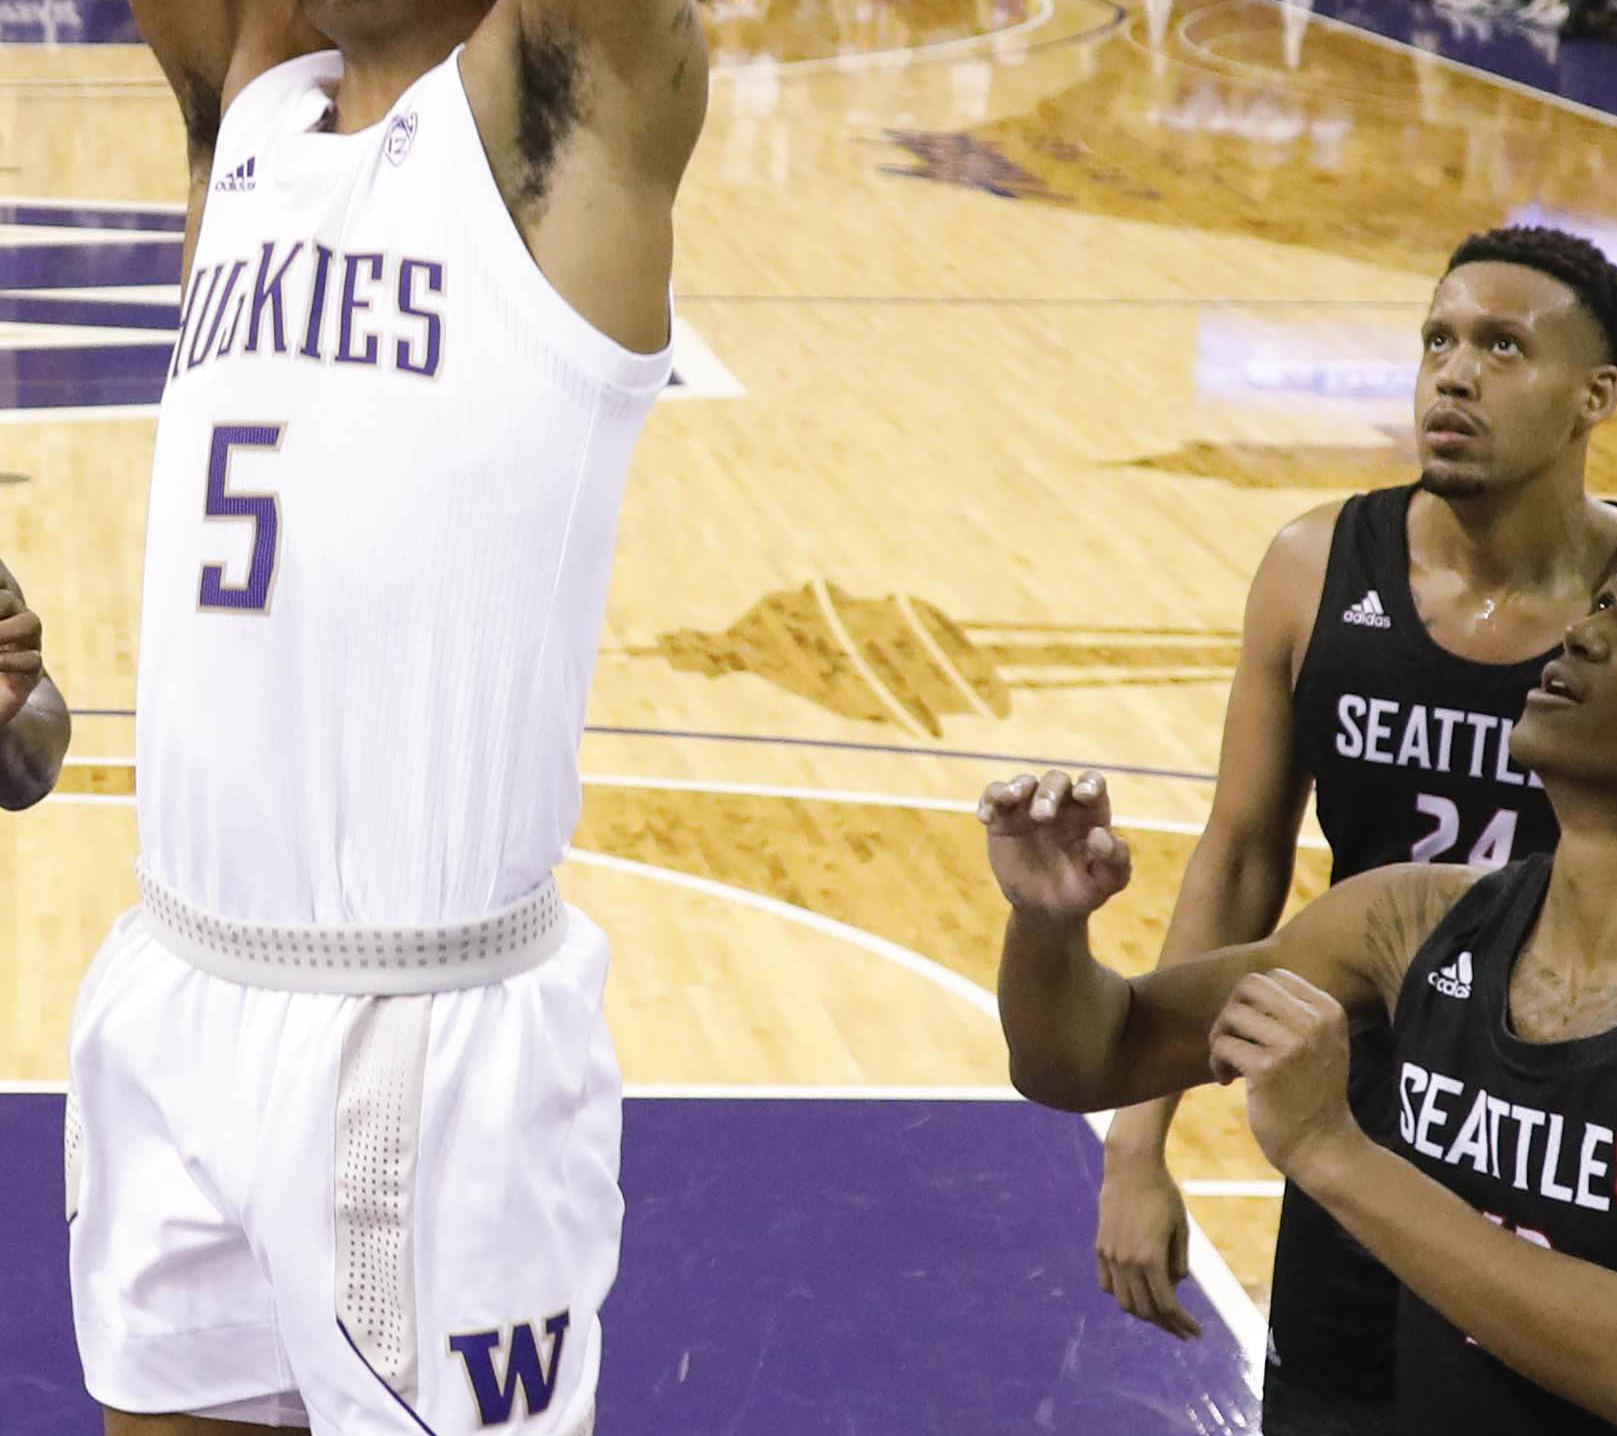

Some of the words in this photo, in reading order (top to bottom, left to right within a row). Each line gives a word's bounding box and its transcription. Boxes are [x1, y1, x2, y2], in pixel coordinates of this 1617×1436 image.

[195, 419, 288, 617] 5
[1342, 610, 1392, 630] adidas
[1334, 692, 1547, 789] SEATTL
[1409, 791, 1520, 864] 24
[447, 1307, 572, 1431] W
